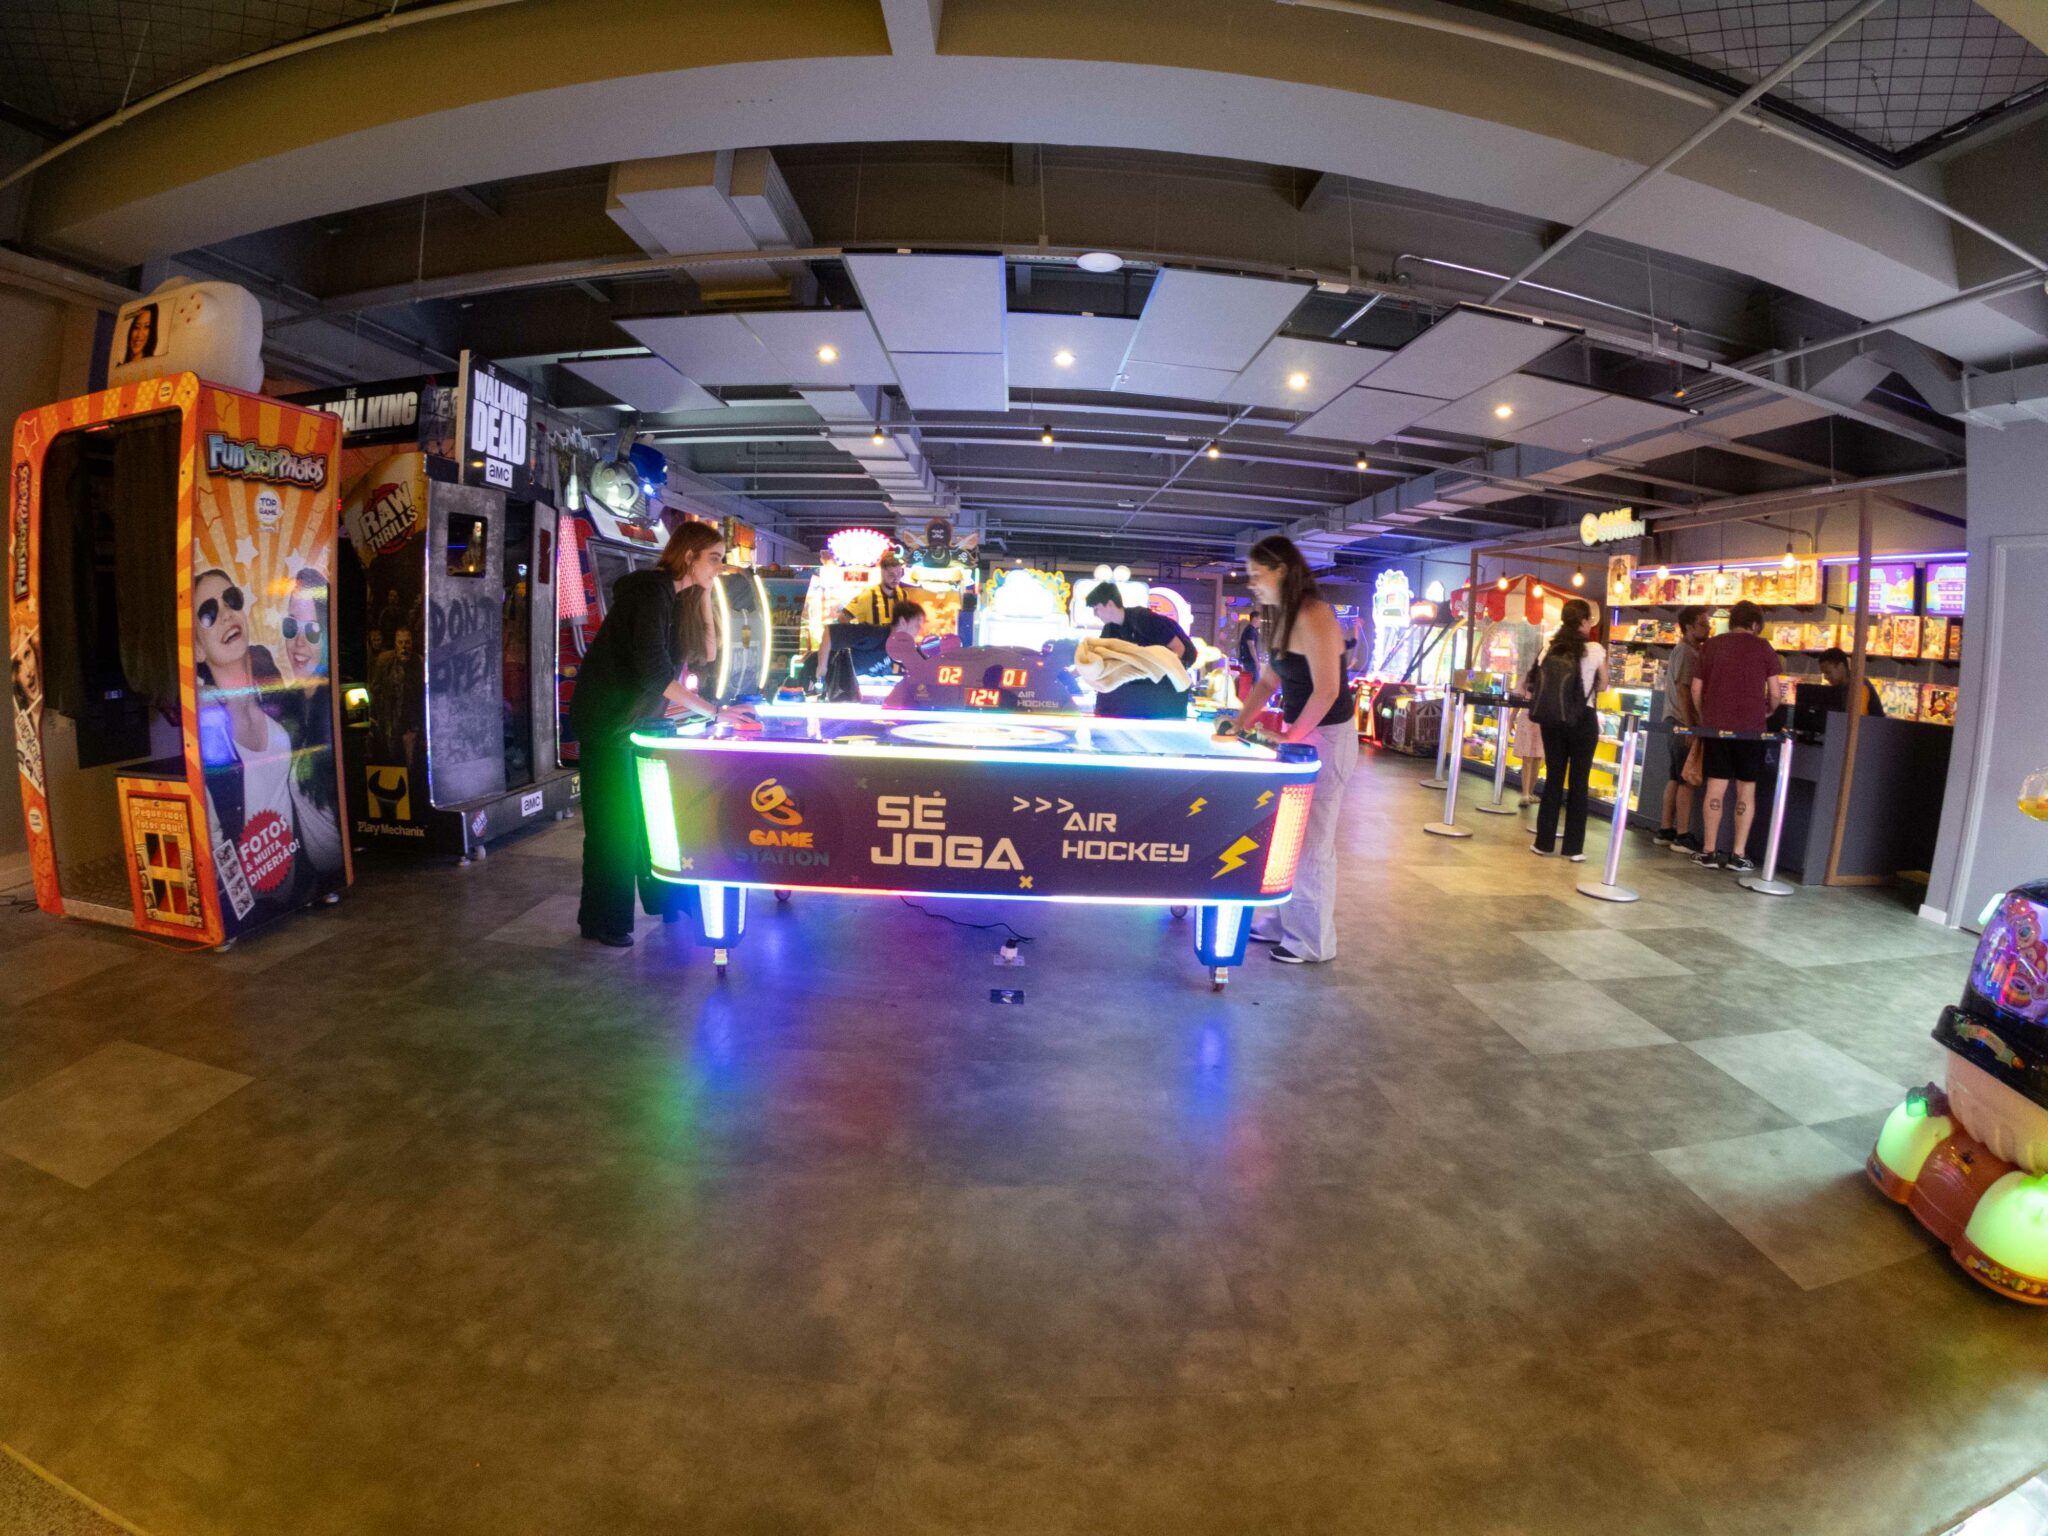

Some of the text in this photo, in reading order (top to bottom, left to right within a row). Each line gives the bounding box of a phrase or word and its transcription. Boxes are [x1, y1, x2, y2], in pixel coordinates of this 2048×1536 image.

[474, 369, 528, 420] WALKING
[471, 399, 527, 466] DEAD
[259, 508, 278, 516] GAME
[260, 497, 277, 506] TOP
[360, 481, 412, 541] RAW
[367, 505, 419, 553] THRILLS
[938, 667, 962, 685] 02
[1003, 669, 1028, 687] 01
[969, 689, 1000, 706] 124
[1016, 699, 1059, 709] HOCKEY
[1017, 690, 1035, 699] AIR
[877, 795, 947, 831] SE
[1063, 811, 1118, 833] AIR
[240, 815, 288, 862] FOTOS
[358, 820, 425, 838] Play Mechanix
[748, 828, 814, 849] GAME
[248, 838, 301, 886] DIVERSÃO!
[252, 839, 282, 867] MUITA
[735, 848, 830, 867] STATION
[870, 832, 1025, 871] JOGA
[1062, 839, 1190, 863] HOCKEY
